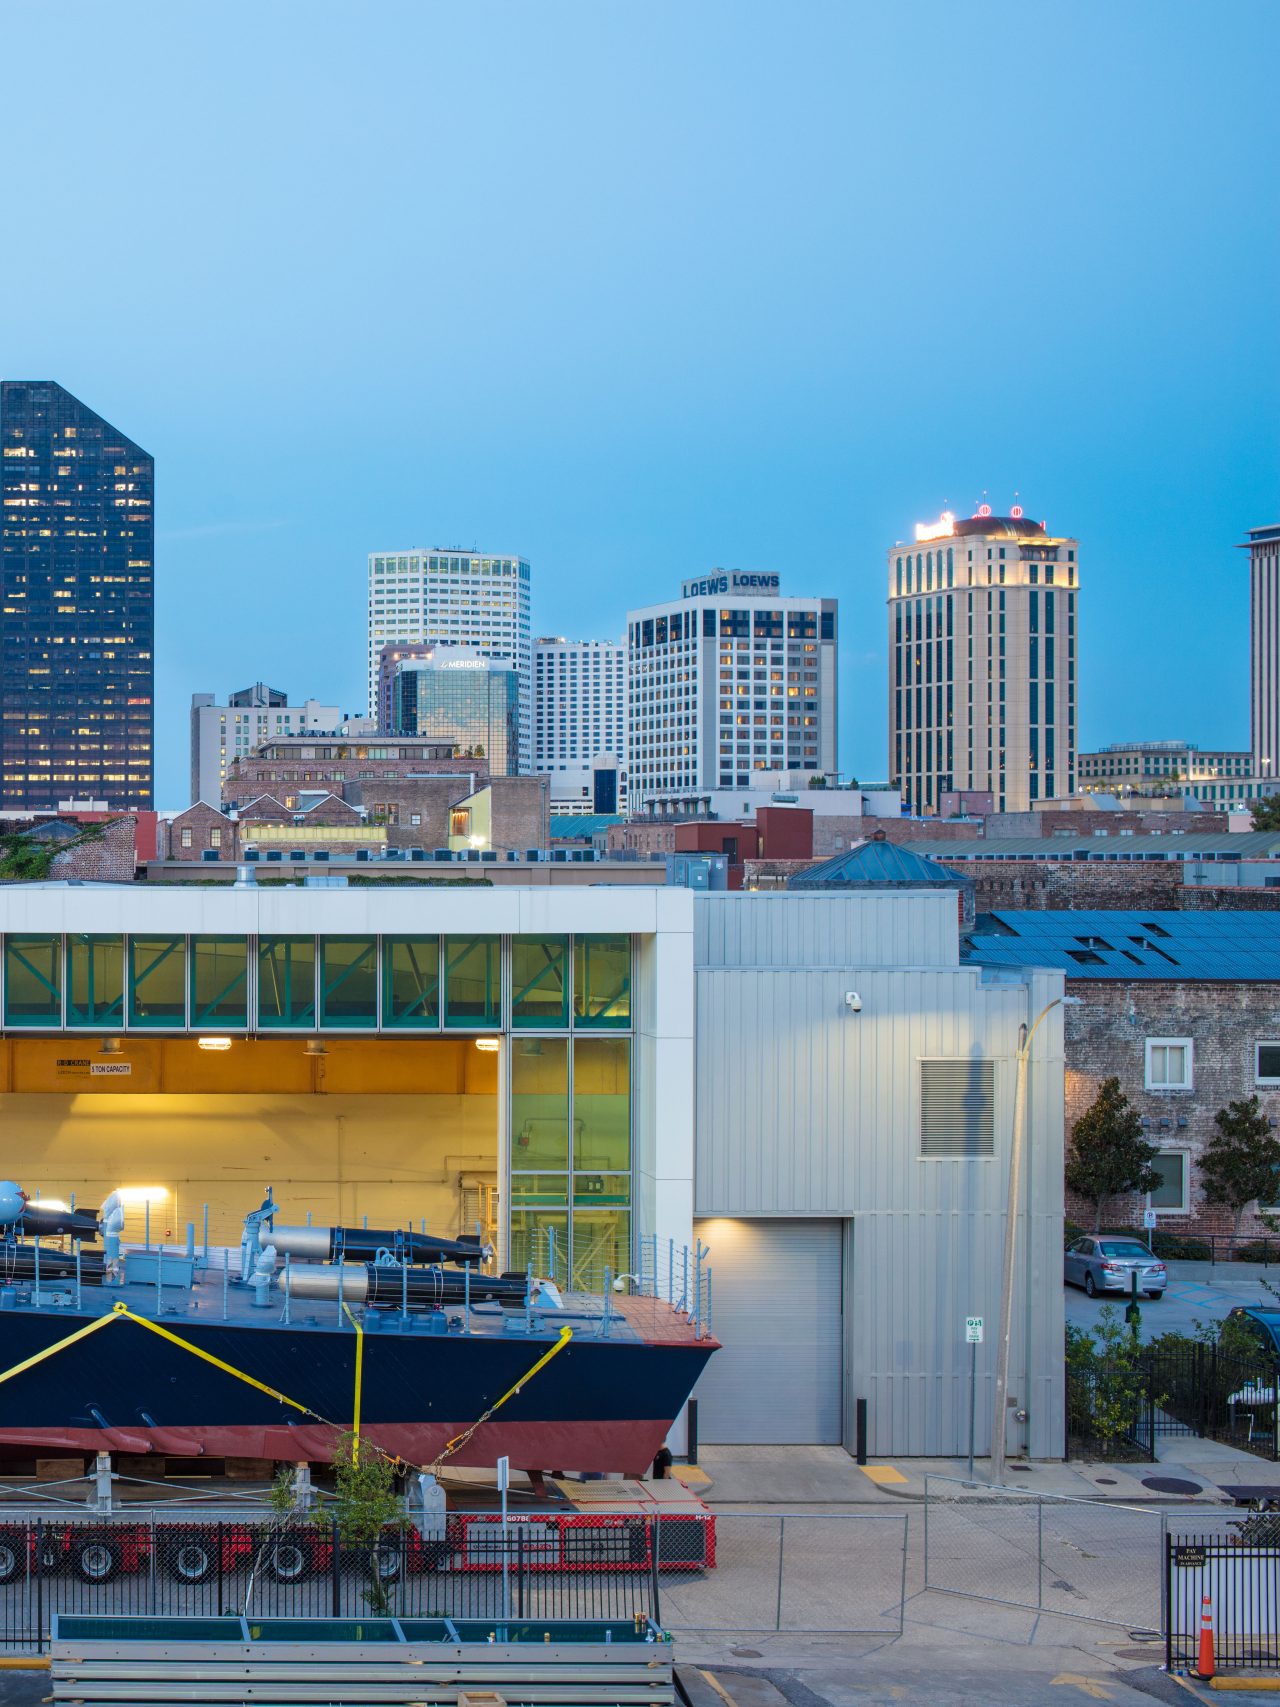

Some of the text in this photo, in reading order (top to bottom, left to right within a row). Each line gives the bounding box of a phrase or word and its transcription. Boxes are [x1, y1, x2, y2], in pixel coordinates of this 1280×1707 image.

[732, 574, 779, 587] LOEWS
[683, 575, 728, 599] LOEWS
[448, 660, 485, 668] MERIDIEN
[96, 1065, 105, 1073] TON
[106, 1065, 130, 1073] CAPACITY
